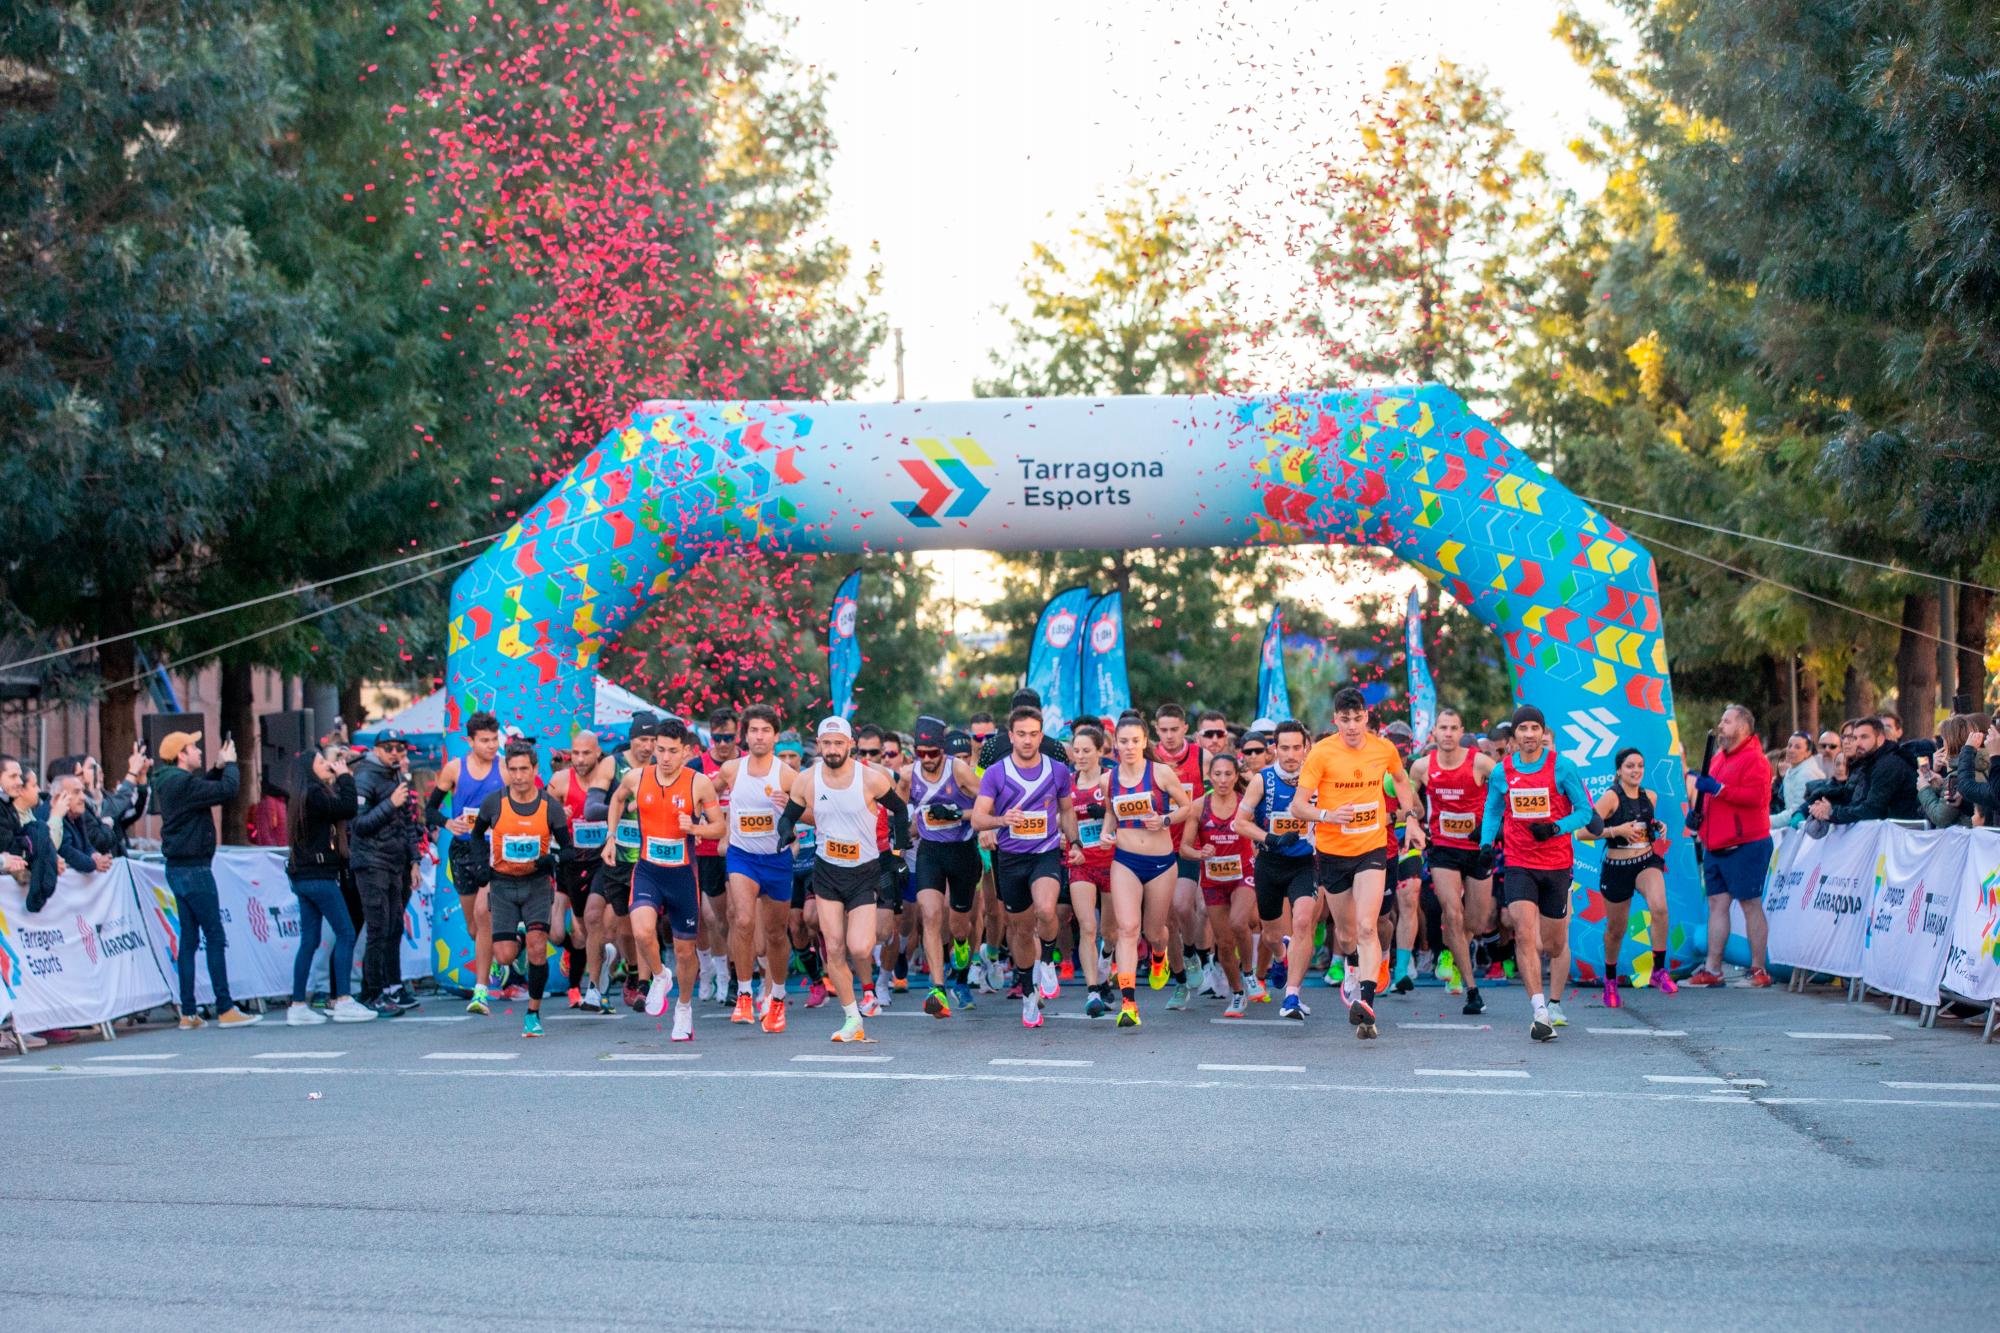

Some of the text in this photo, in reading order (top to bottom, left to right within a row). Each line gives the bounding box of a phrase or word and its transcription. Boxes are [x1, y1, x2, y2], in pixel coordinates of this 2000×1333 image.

[1018, 458, 1164, 482] Tarragona
[1024, 486, 1131, 510] Esports
[1119, 800, 1150, 813] 6001
[1515, 796, 1546, 807] 5243
[740, 815, 773, 827] 5009
[1276, 819, 1307, 829] 5362
[1443, 819, 1473, 829] 5270
[584, 829, 601, 839] 311
[512, 842, 533, 853] 149
[656, 845, 677, 856] 681
[829, 842, 857, 854] 5162
[17, 927, 65, 951] Tarragona
[26, 953, 63, 979] Esports
